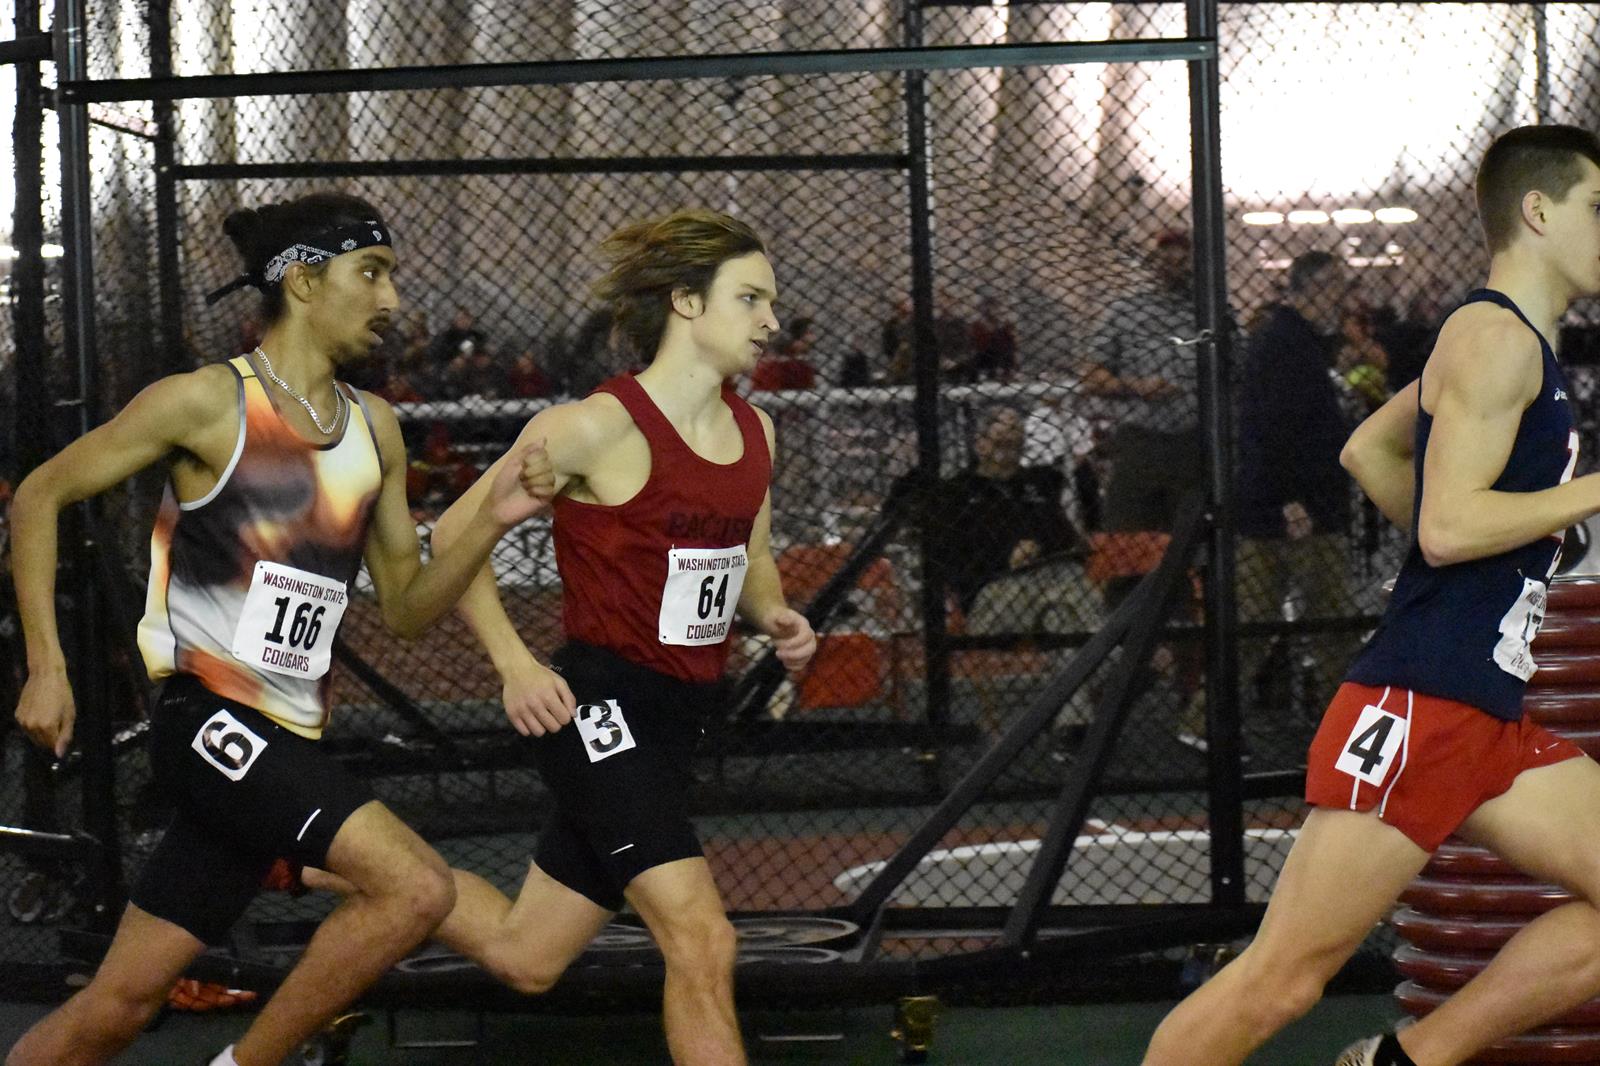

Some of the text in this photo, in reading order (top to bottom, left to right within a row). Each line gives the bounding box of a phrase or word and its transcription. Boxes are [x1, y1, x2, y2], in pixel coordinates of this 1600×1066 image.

[678, 554, 746, 571] WASHINGTON STATE
[263, 571, 345, 605] WASHINGTON STATE
[697, 573, 729, 620] 64
[264, 596, 326, 651] 166
[686, 622, 727, 639] COUGARS
[261, 646, 309, 672] COUGARS
[201, 720, 253, 771] 6
[579, 699, 623, 753] 3
[1347, 714, 1396, 776] 4
